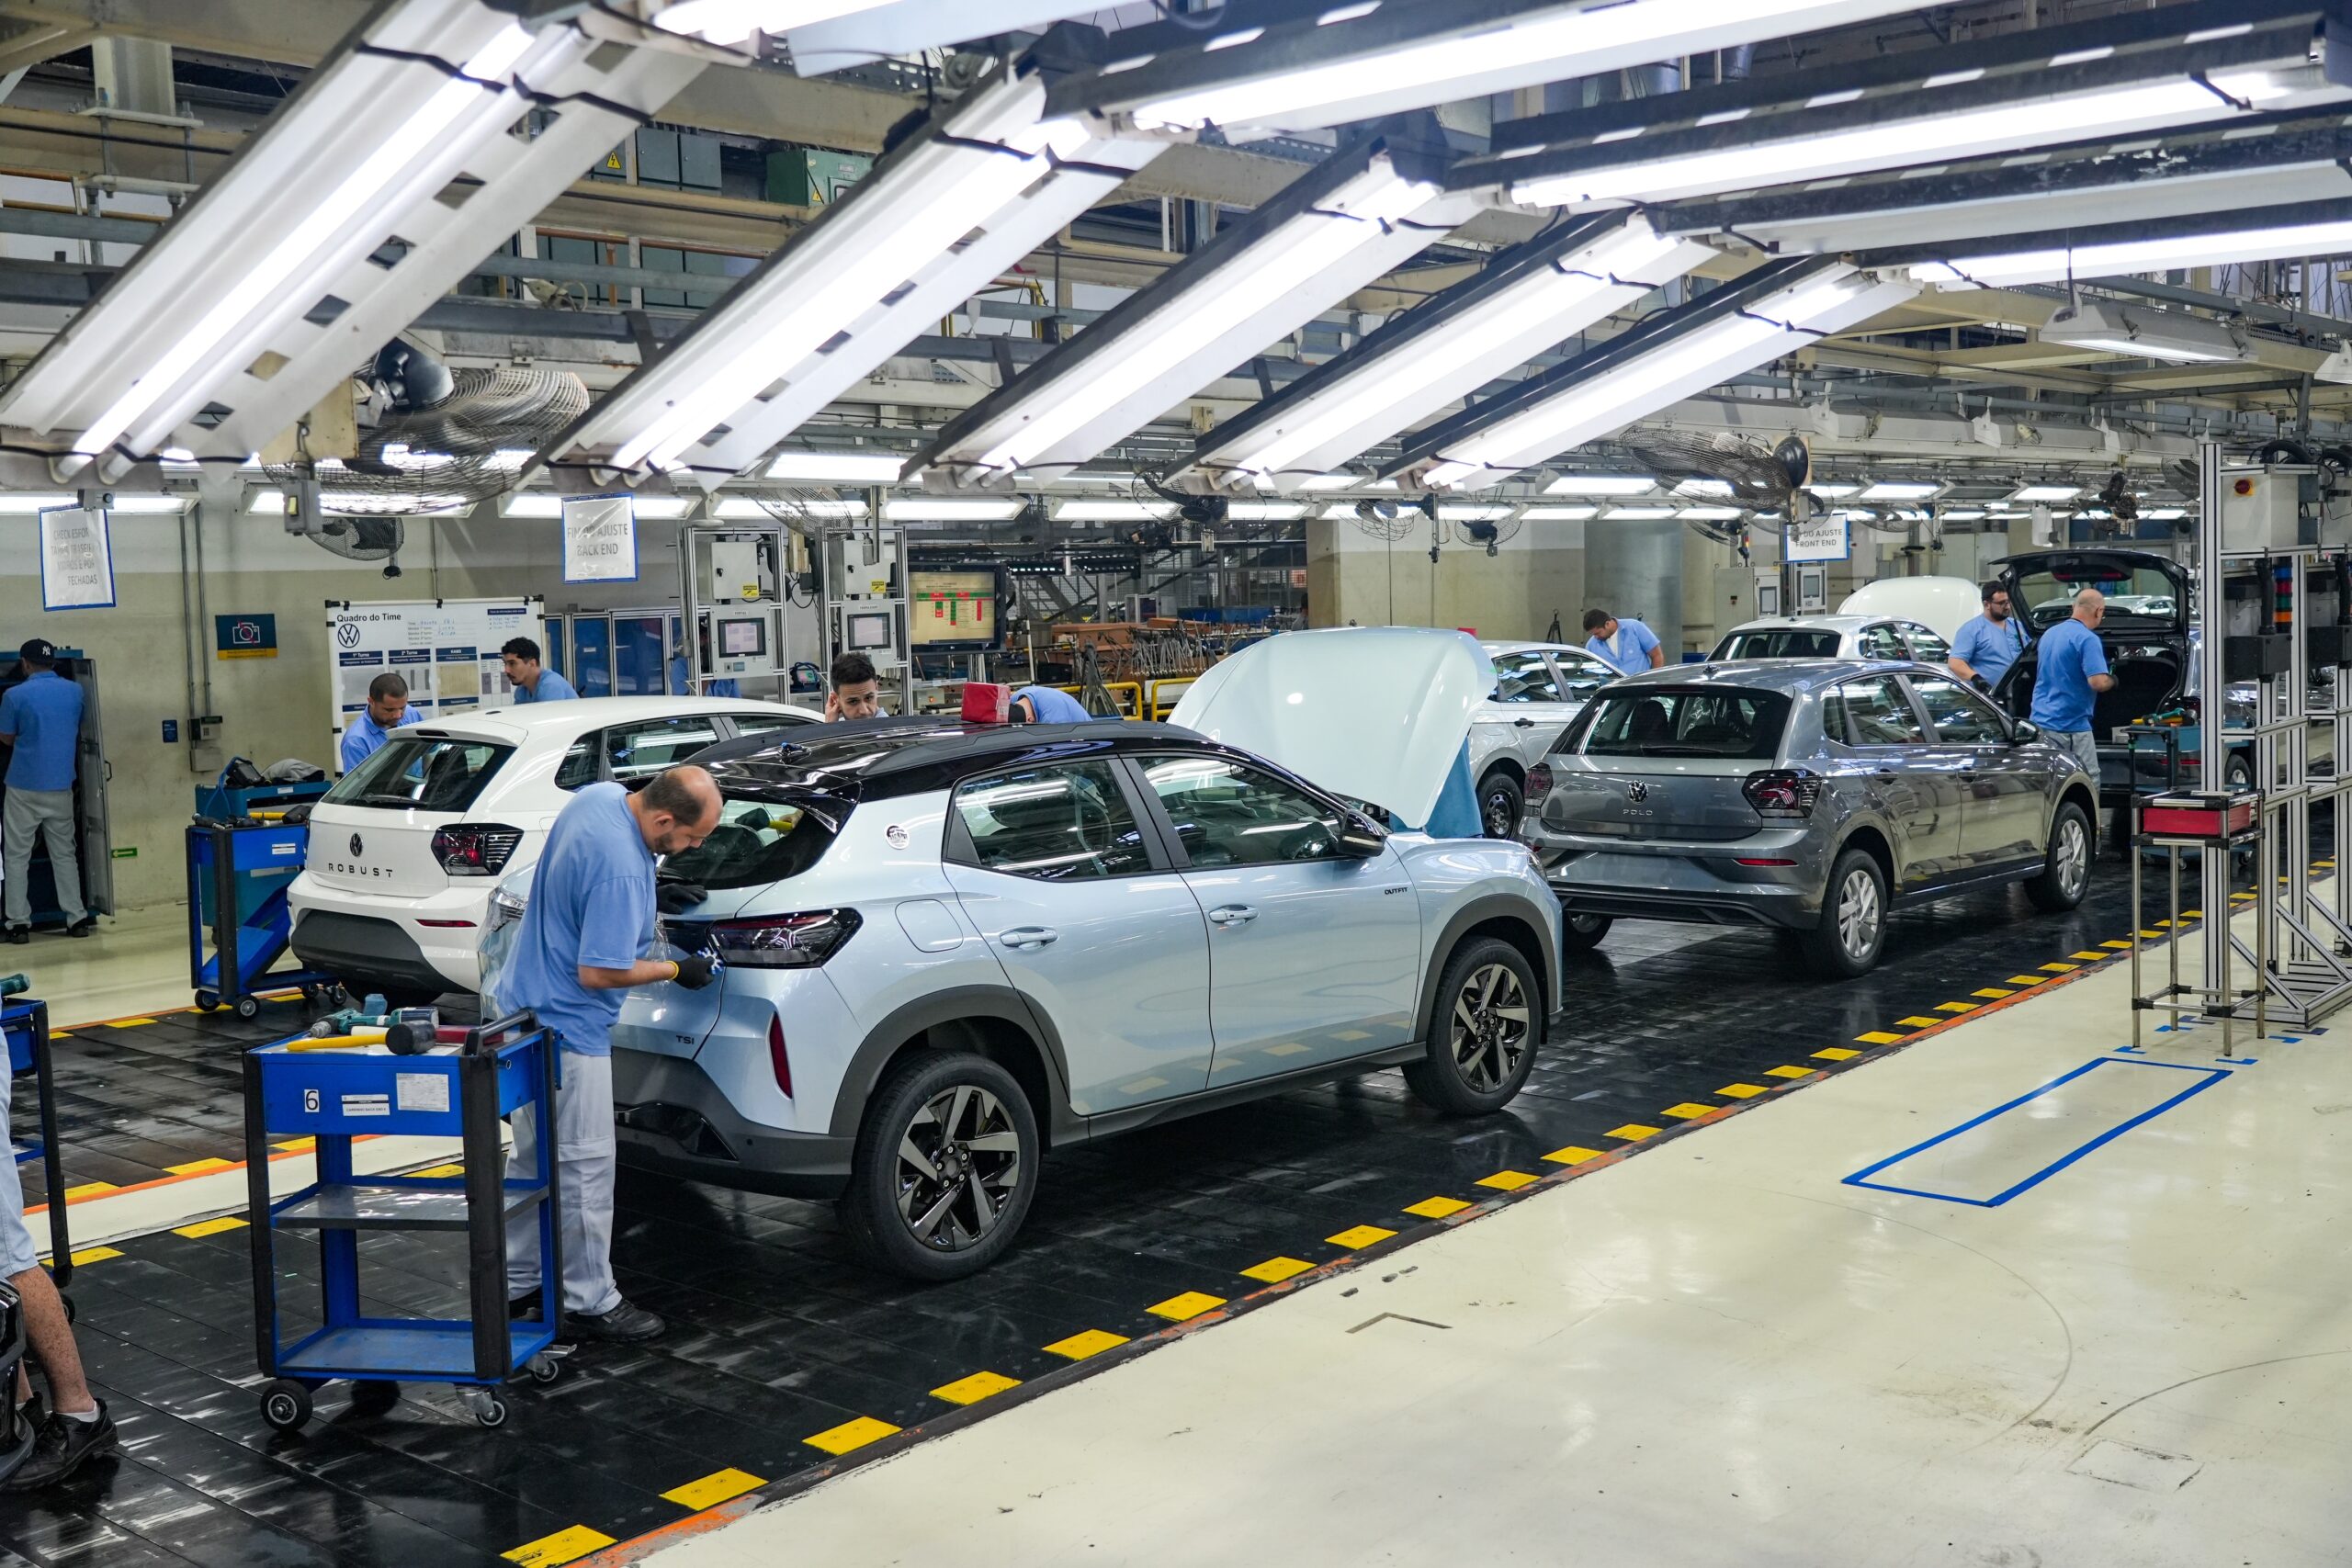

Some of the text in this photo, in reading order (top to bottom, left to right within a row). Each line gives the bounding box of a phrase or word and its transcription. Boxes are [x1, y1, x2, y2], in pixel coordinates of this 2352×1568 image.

[71, 527, 89, 539] ESFOR
[597, 523, 628, 536] AJUSTE
[1815, 528, 1843, 536] AJUSTE
[576, 543, 618, 557] BACK END
[68, 574, 97, 586] FECHADAS
[336, 614, 368, 623] Quadro
[382, 613, 401, 621] Time
[328, 863, 393, 878] ROBUST
[1384, 886, 1408, 896] OUTFIT
[675, 1034, 695, 1045] TSI
[305, 1090, 319, 1111] 6
